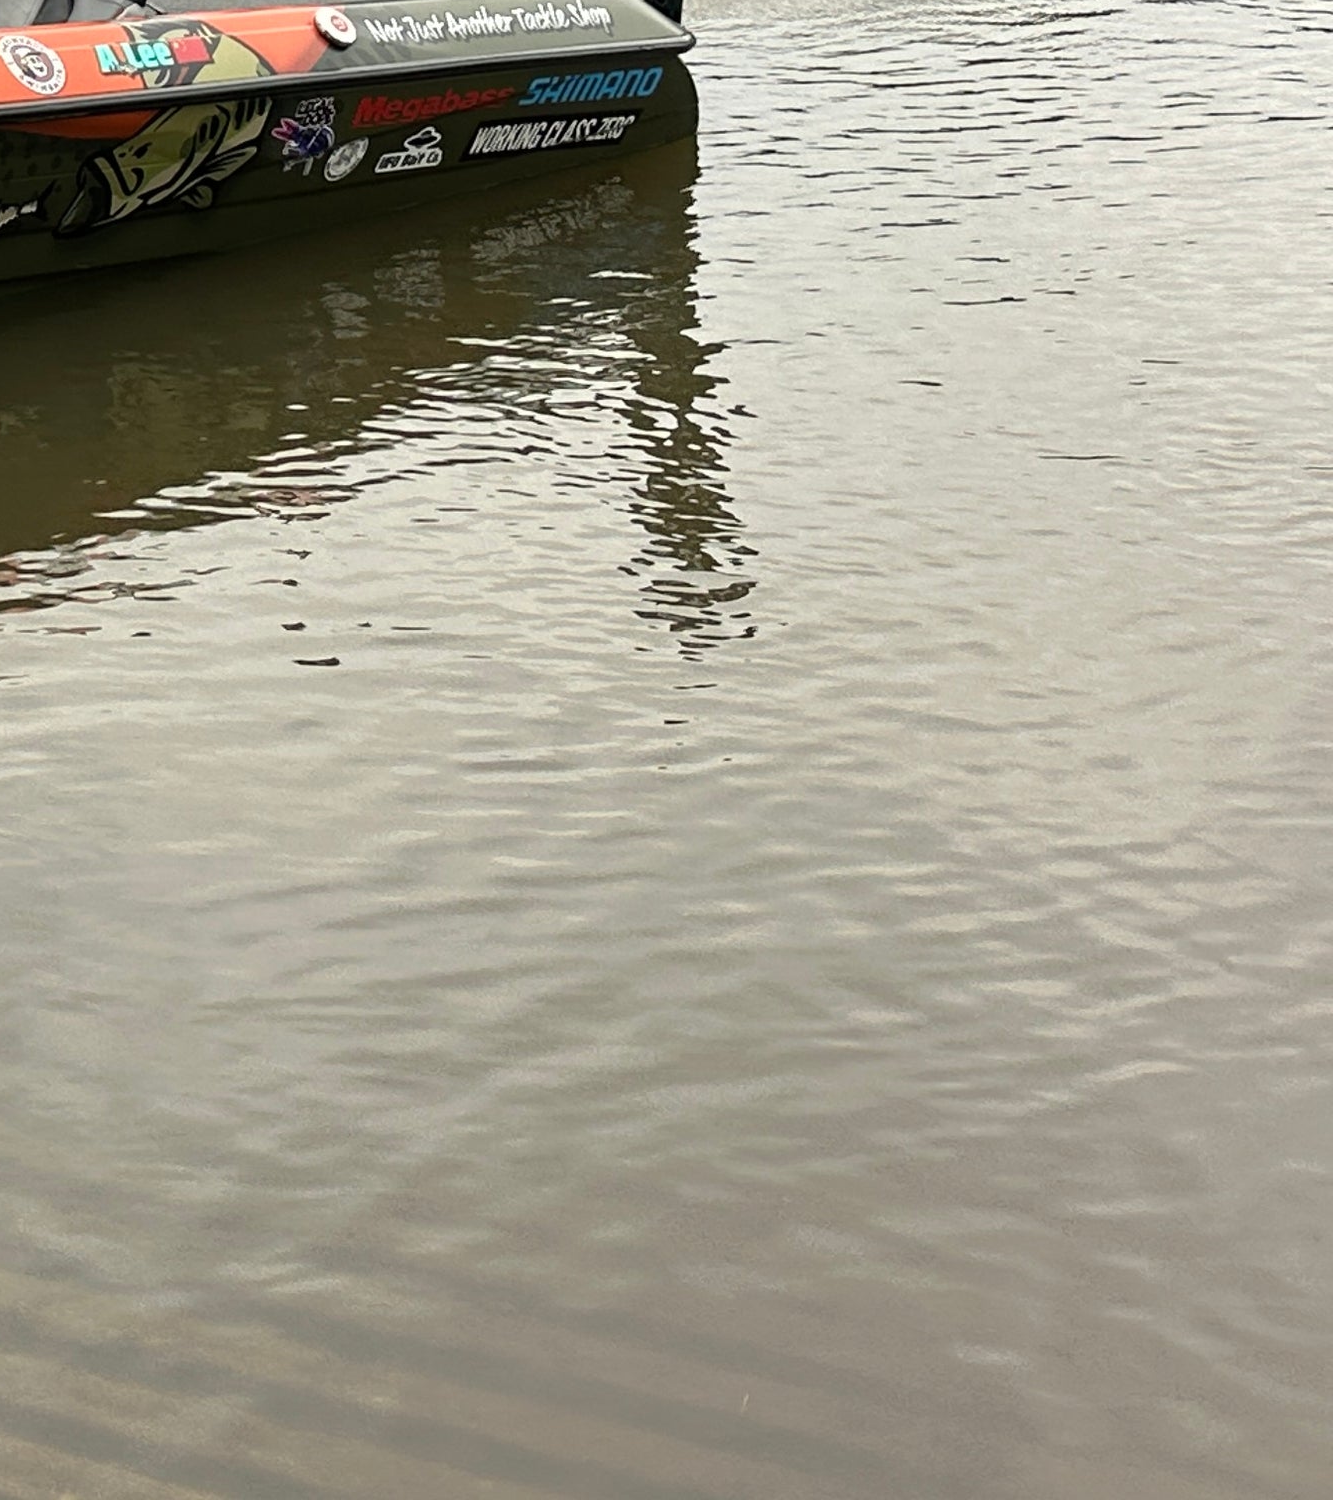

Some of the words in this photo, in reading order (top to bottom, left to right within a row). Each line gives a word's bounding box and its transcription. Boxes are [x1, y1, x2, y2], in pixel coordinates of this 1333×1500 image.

[364, 18, 403, 43] Not
[401, 14, 445, 43] Just
[445, 5, 513, 38] Another
[511, 2, 569, 32] Tackle
[518, 66, 664, 106] SHIMANO
[351, 87, 516, 128] Megabass
[469, 121, 547, 155] WORKING
[541, 117, 598, 149] CLASS
